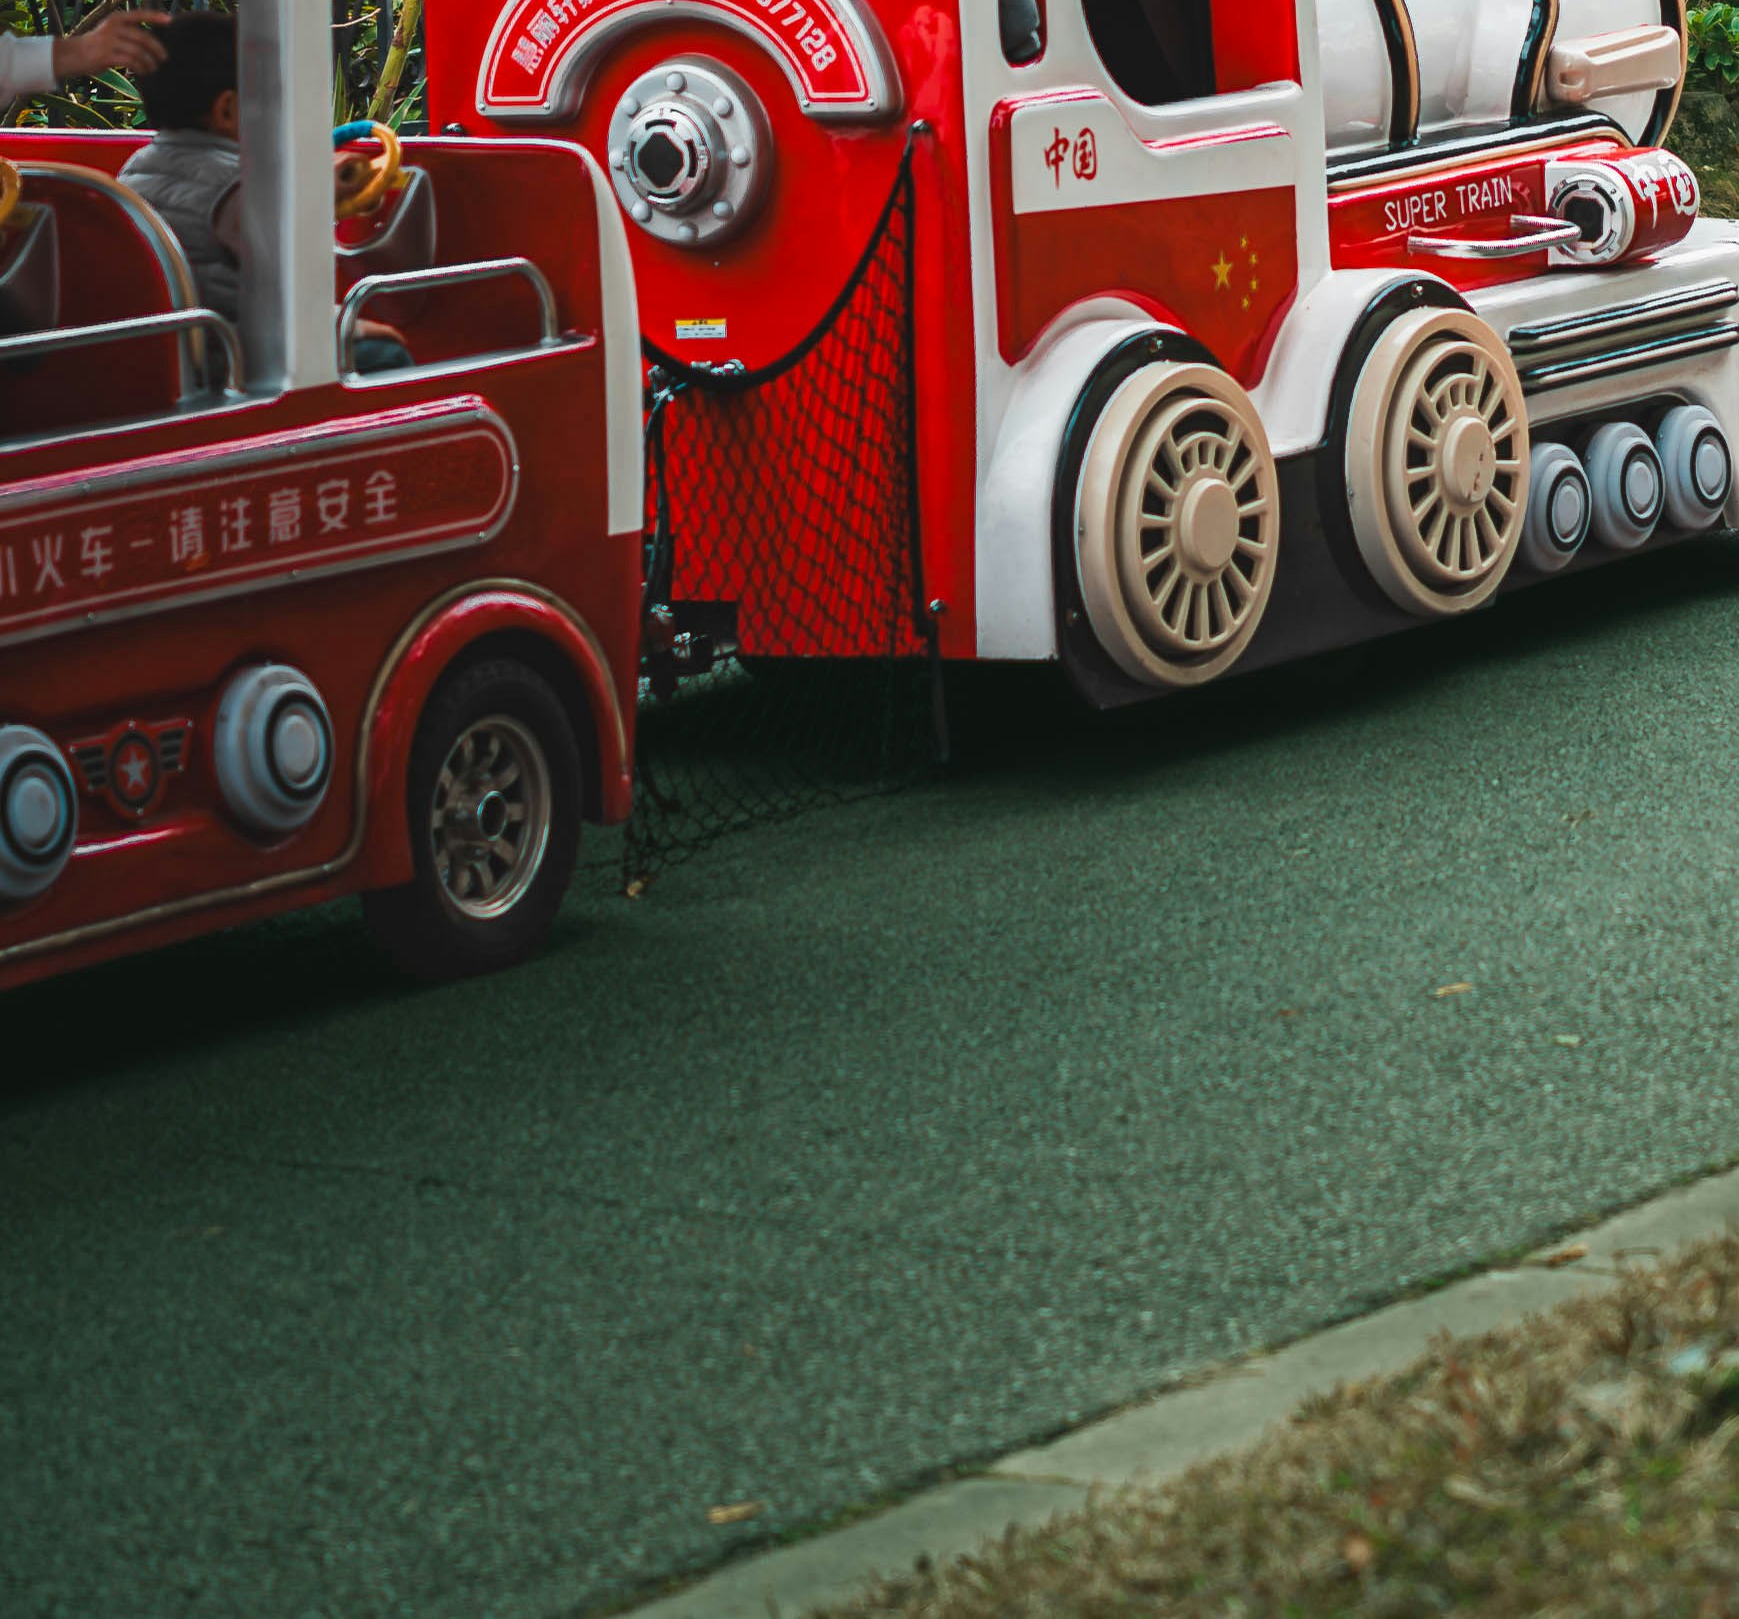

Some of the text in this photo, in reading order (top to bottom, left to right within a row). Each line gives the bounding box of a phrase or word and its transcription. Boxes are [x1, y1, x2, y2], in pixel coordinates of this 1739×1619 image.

[1043, 126, 1097, 189] 中国
[1384, 175, 1513, 231] SUPER TRAIN
